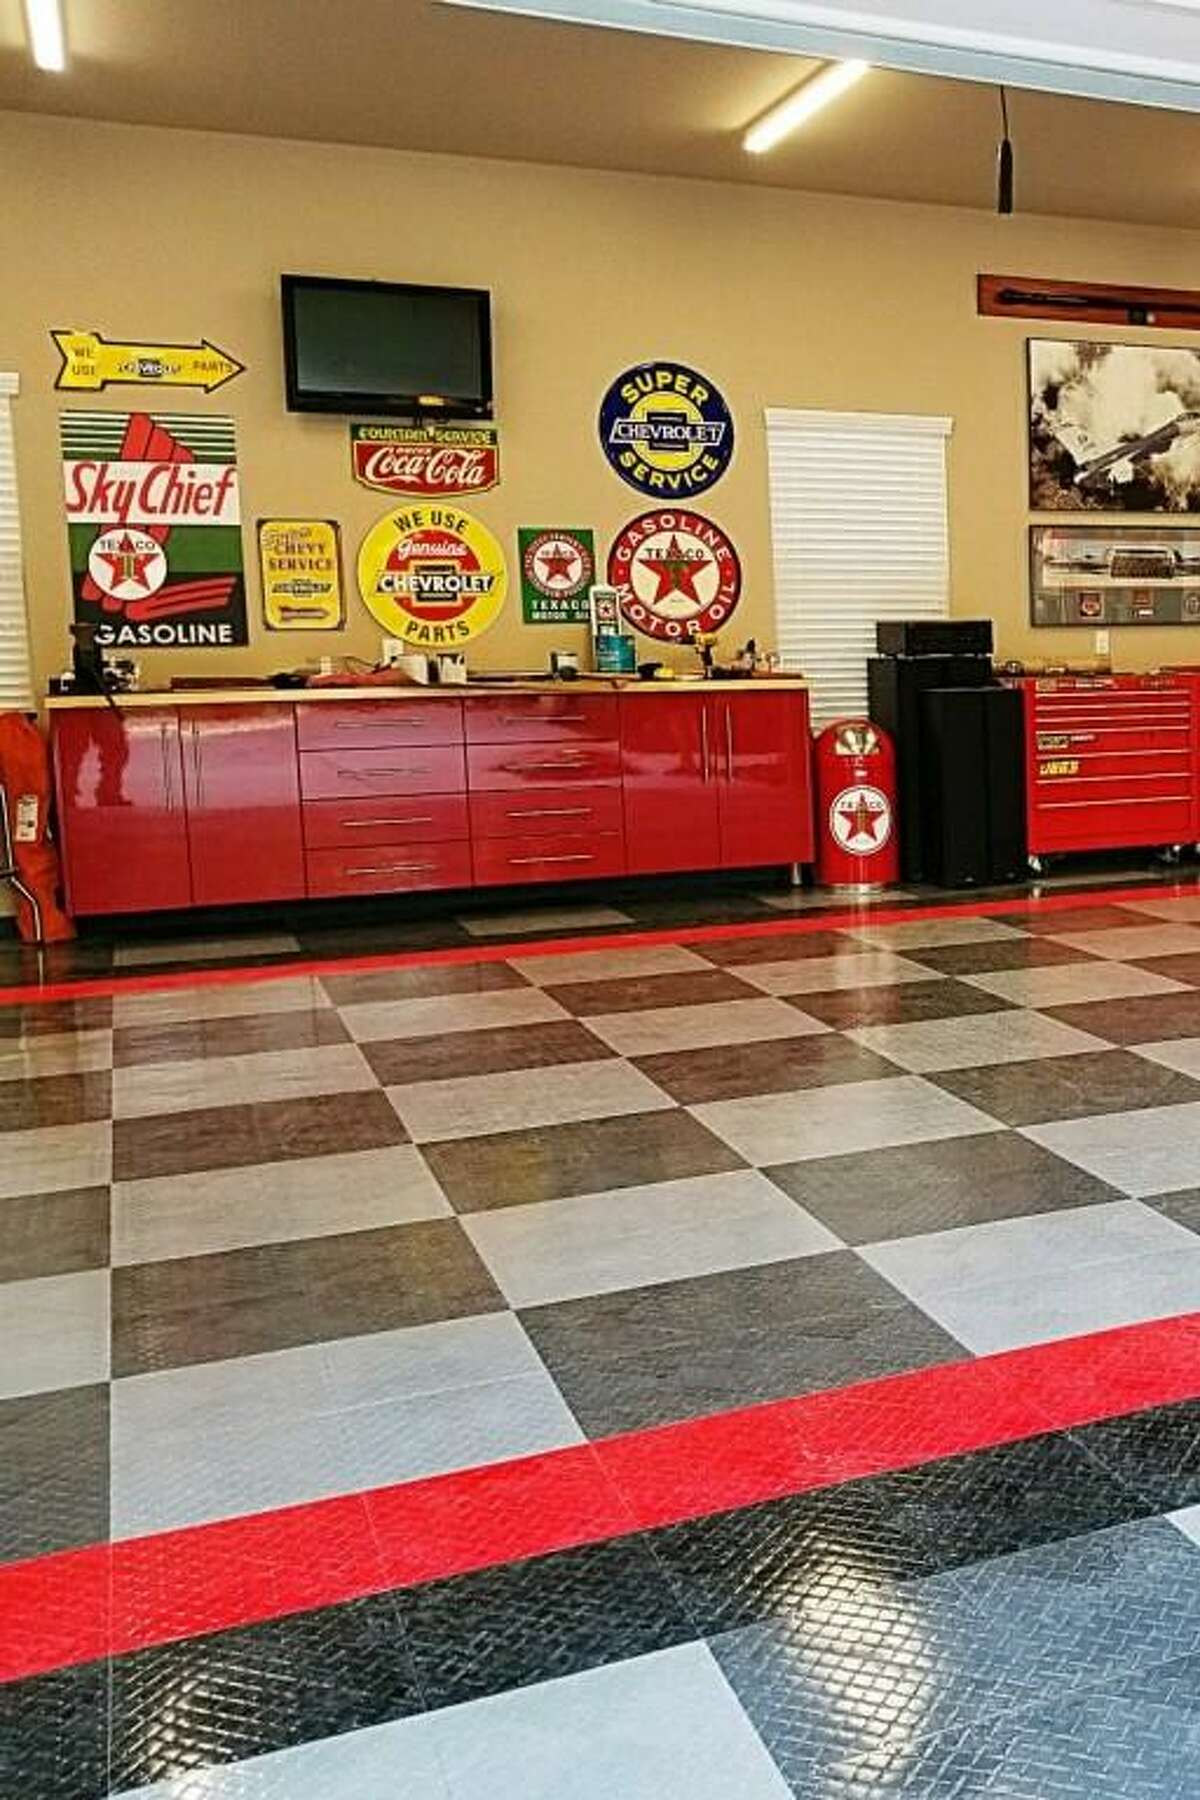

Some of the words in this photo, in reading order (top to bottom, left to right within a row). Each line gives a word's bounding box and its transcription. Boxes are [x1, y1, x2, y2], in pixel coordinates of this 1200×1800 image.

[73, 346, 95, 359] WE
[72, 364, 96, 376] USE
[192, 360, 234, 374] PARTS
[620, 370, 709, 406] SUPER
[359, 427, 429, 441] FOUNTAIN
[436, 430, 492, 443] SERVICE
[618, 423, 720, 441] CHEVROLET
[620, 451, 719, 489] SERVICE
[65, 460, 136, 524] Sky
[139, 463, 237, 516] Chief
[393, 510, 425, 532] WE
[431, 510, 469, 534] USE
[100, 538, 155, 551] TEXACO
[616, 514, 732, 562] GASOLINE
[645, 548, 704, 560] TEXACO
[269, 558, 332, 570] SERVICE
[381, 574, 492, 594] CHEVROLET
[532, 600, 590, 610] TEXACO
[617, 583, 702, 636] MOTOR
[708, 582, 735, 620] OIL
[94, 623, 233, 645] GASOLINE
[405, 620, 470, 643] PARTS
